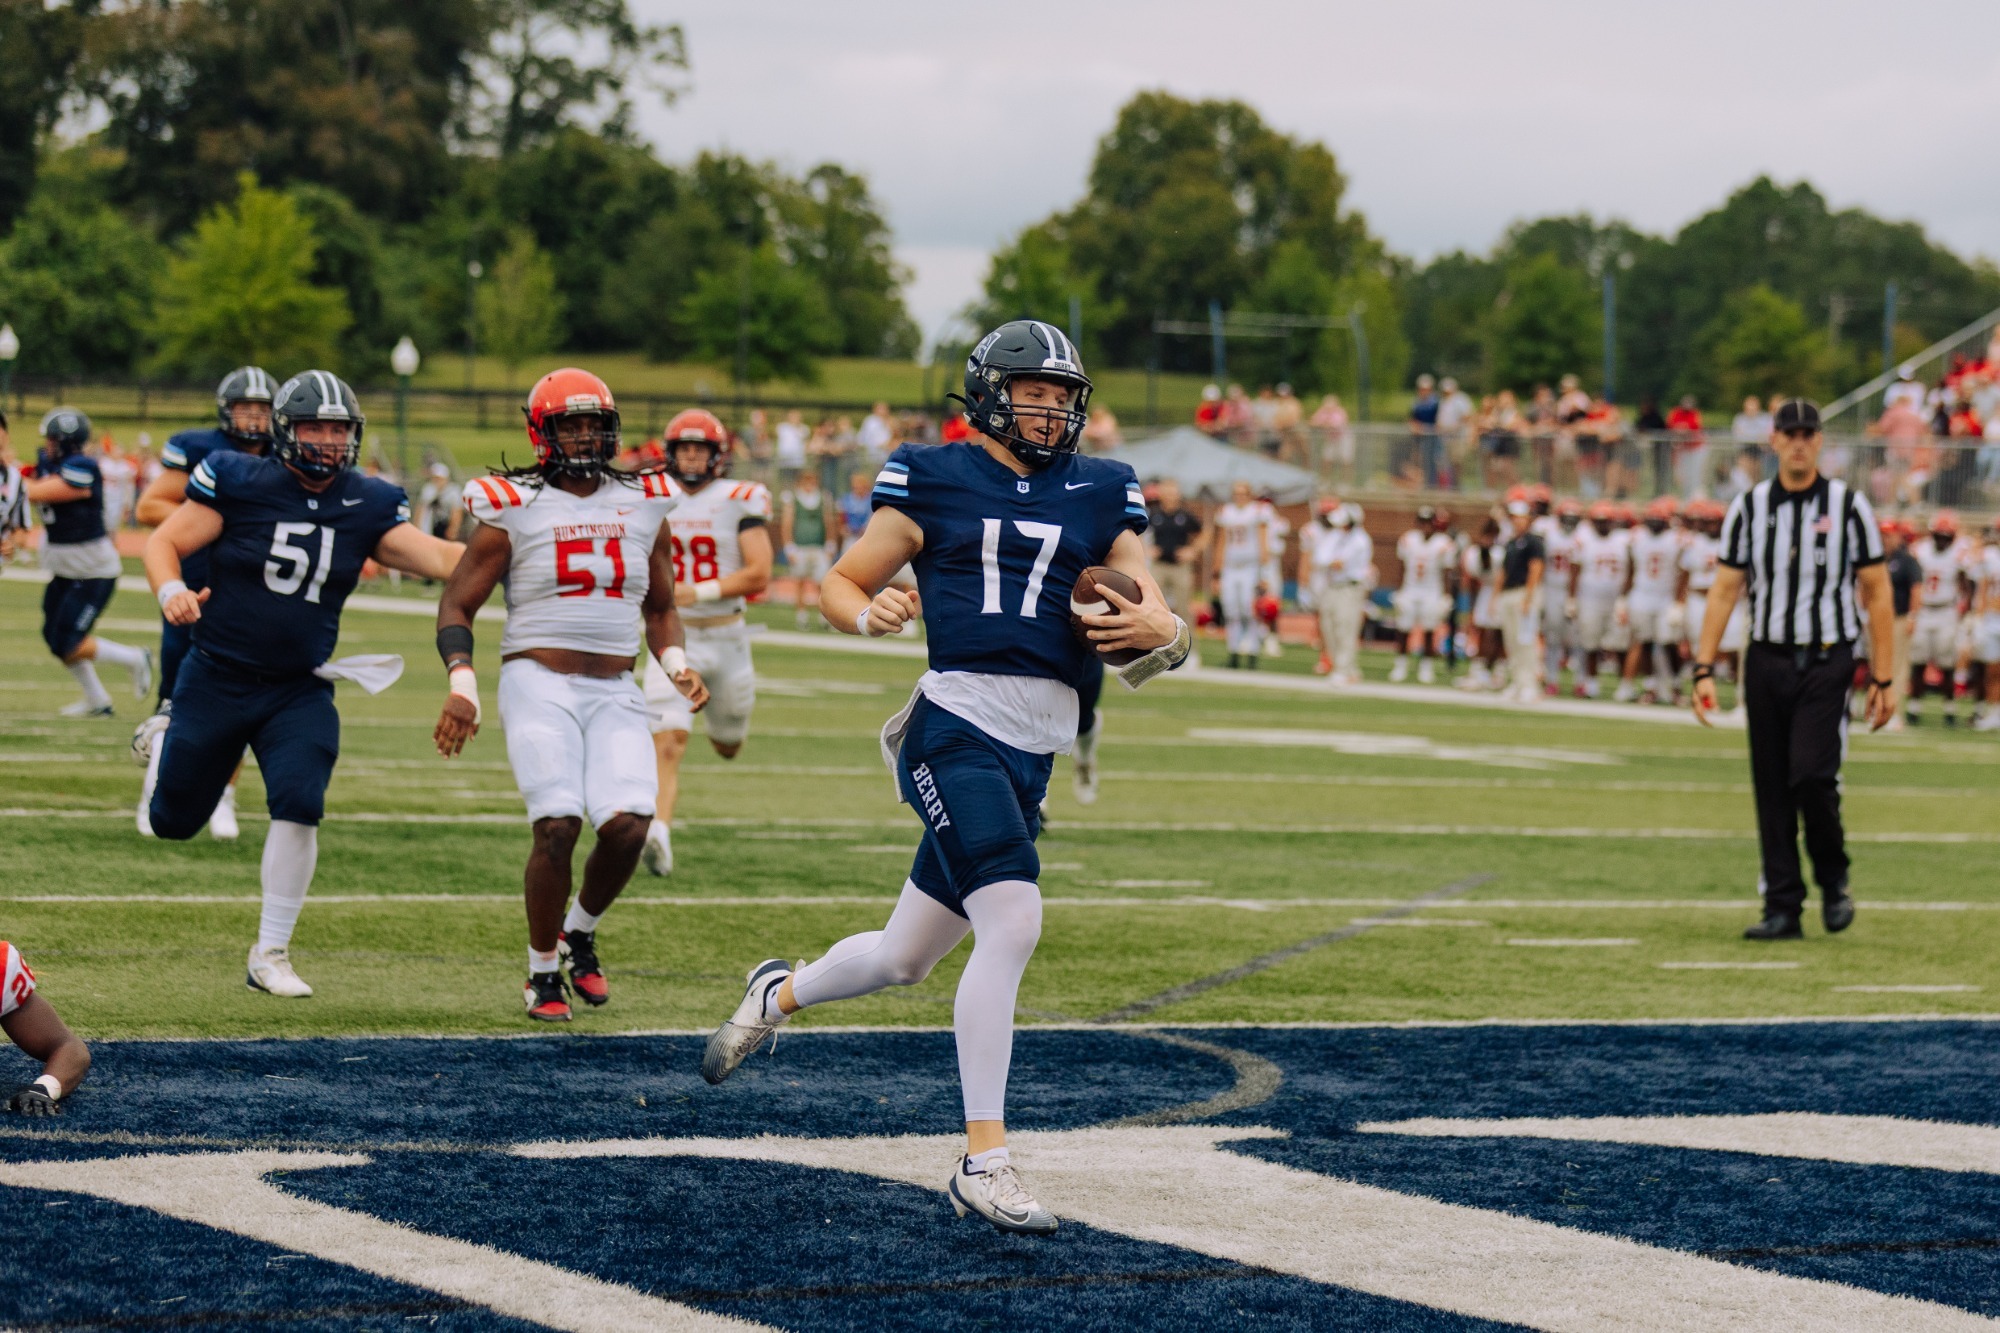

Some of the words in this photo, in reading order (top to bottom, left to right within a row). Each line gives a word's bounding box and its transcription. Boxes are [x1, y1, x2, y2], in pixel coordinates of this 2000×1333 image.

[263, 521, 335, 604] 51
[553, 523, 626, 541] HUNTINGDON
[556, 537, 626, 599] 51
[980, 518, 1062, 618] 17
[912, 762, 951, 833] BERRY
